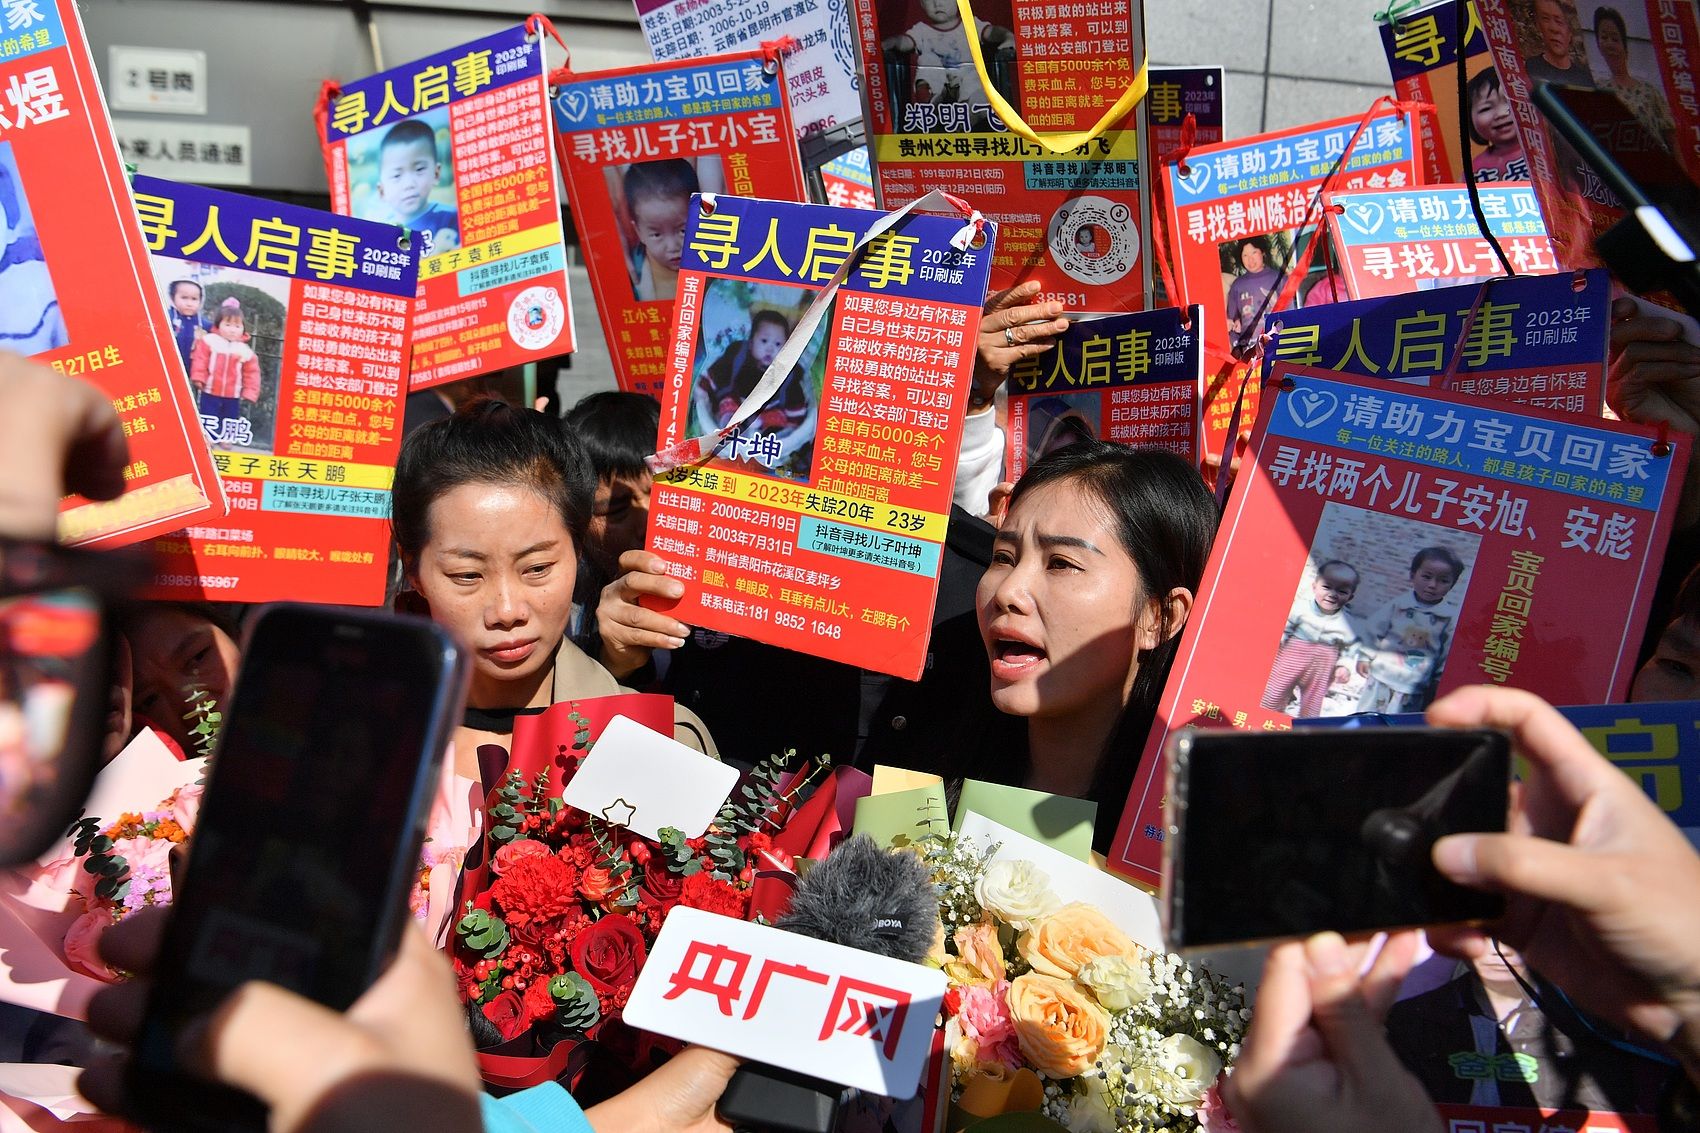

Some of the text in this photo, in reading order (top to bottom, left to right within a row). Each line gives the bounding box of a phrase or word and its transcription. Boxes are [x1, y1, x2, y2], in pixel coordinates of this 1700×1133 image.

[0, 0, 45, 31] 家
[1017, 1, 1127, 21] 积极勇敢的站出来
[0, 28, 52, 57] 的希望
[1020, 20, 1128, 39] 寻找答案，可以到
[1021, 39, 1129, 57] 当地公安部门登记
[495, 58, 528, 76] 印刷版
[788, 66, 825, 91] 双眼皮
[1023, 58, 1130, 75] 全国有5000余个免
[0, 65, 70, 131] 煜
[331, 44, 533, 135] 寻人启事 2023年
[590, 65, 770, 110] 请助力宝贝回家
[790, 81, 830, 108] 穴头发
[869, 63, 885, 124] 38581
[1024, 76, 1131, 92] 费采血点，您与父
[1150, 81, 1182, 122] 事
[1028, 113, 1075, 127] 血的距离
[1406, 78, 1443, 185] 宝贝家编号417
[573, 113, 780, 164] 寻找儿子江小宝
[1214, 119, 1403, 180] 请助力宝贝回家
[460, 165, 547, 201] 全国有5000余个
[1032, 162, 1140, 176] 抖音寻找儿子郑明飞
[1218, 147, 1404, 194] 每一位关注的路人，都是回家的希望
[1386, 193, 1540, 224] 请助力宝贝
[135, 193, 361, 280] 寻人启事
[363, 247, 411, 267] 2023年
[1394, 221, 1546, 239] 每一位关注的路，都是孩子
[690, 213, 977, 289] 寻人启事 2023年
[1362, 238, 1558, 280] 寻找儿子杜
[361, 262, 402, 281] 印刷版
[470, 252, 550, 282] 抖音寻找儿子袁辉
[919, 268, 965, 285] 印刷版
[303, 284, 407, 315] 如果您身边有怀疑
[844, 295, 967, 327] 如果您身边有怀疑
[301, 302, 405, 331] 自己身世来历不明
[841, 315, 963, 347] 自己身世来历不明
[300, 320, 403, 347] 或被收养的孩子请
[1275, 302, 1592, 374] 寻人启事 2023年
[1525, 326, 1578, 347] 印刷版
[298, 336, 402, 363] 积极勇敢的站出来
[838, 337, 959, 369] 或被收养的孩子请
[1013, 329, 1191, 391] 寻人启事 2023年
[1154, 351, 1184, 366] 印刷版
[296, 353, 400, 380] 寻找答案，可以到
[834, 356, 956, 389] 积极勇敢的站出来
[295, 371, 398, 397] 当地公安部门登记
[831, 376, 953, 410] 寻找答案，可以到
[1111, 385, 1192, 405] 如果您身边有怀疑
[113, 387, 162, 413] 批发市场
[293, 391, 396, 412] 全国有5000余个
[828, 395, 949, 431] 当地公安部门登记
[1111, 404, 1191, 422] 自己身世来历不明
[289, 423, 393, 446] 父母的距离就差一
[291, 408, 395, 430] 免费采血点，您与
[825, 416, 945, 451] 全国有5000余个
[1110, 423, 1190, 440] 或被收养的孩子请
[287, 440, 354, 460] 点血的距离
[1342, 393, 1655, 481] 请助力宝贝回家
[213, 454, 346, 483] 爱子张天鹏
[822, 436, 942, 471] 免费采血点，您与
[1335, 428, 1646, 504] 每一位关注的路人，都是孩子回家的希望
[819, 455, 939, 490] 父母的距离就差一
[272, 484, 386, 505] 抖音寻找儿子张天鹏
[722, 477, 737, 493] 到
[749, 482, 875, 521] 2023年失踪20年
[886, 509, 926, 532] 23岁
[816, 476, 890, 503] 点血的距离
[1268, 445, 1637, 561] 寻找两个儿子安旭、安彪
[658, 491, 797, 533] 出生日期：2000年2月19日
[655, 513, 794, 556] 失踪日期：2003年7月31日
[815, 523, 922, 558] 抖音寻找儿子叶坤
[652, 535, 842, 591] 失踪地点：贵州省贵阳市花溪区麦坪乡
[774, 611, 805, 632] 9852
[811, 619, 842, 640] 1648
[1478, 549, 1545, 683] 宝贝回家编号
[878, 918, 903, 929] BOYA
[663, 940, 912, 1062] 央广网
